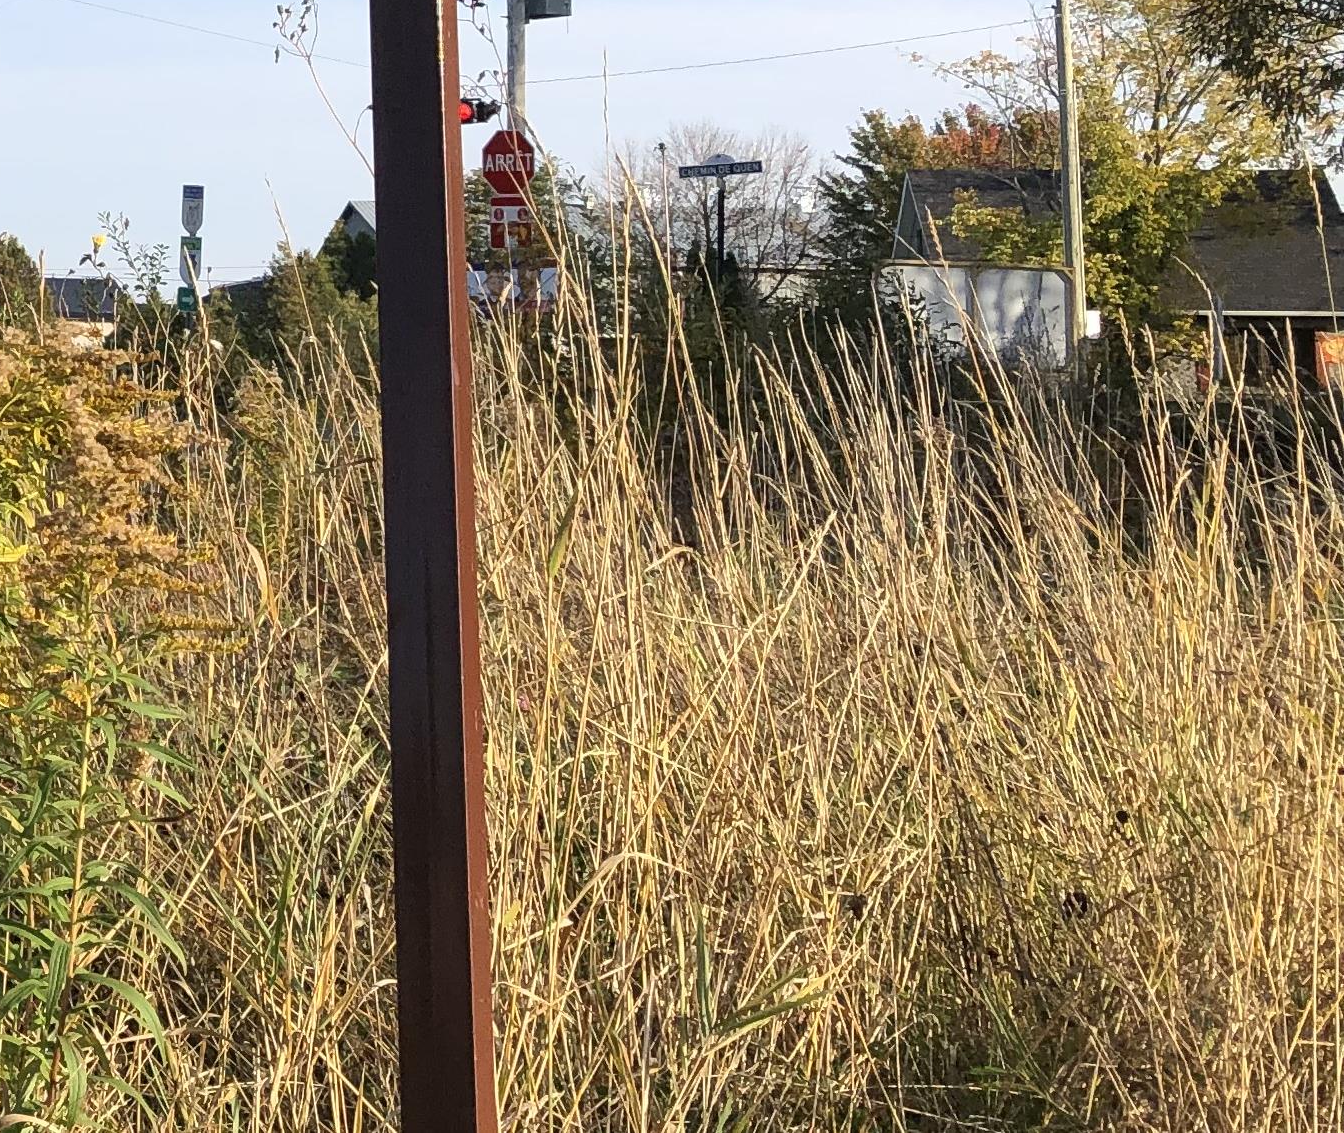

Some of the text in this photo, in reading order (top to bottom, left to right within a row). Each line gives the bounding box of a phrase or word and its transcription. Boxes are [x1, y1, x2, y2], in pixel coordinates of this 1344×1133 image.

[485, 149, 533, 172] ARRÊT
[681, 166, 716, 177] CHEMIN
[718, 165, 731, 174] DE
